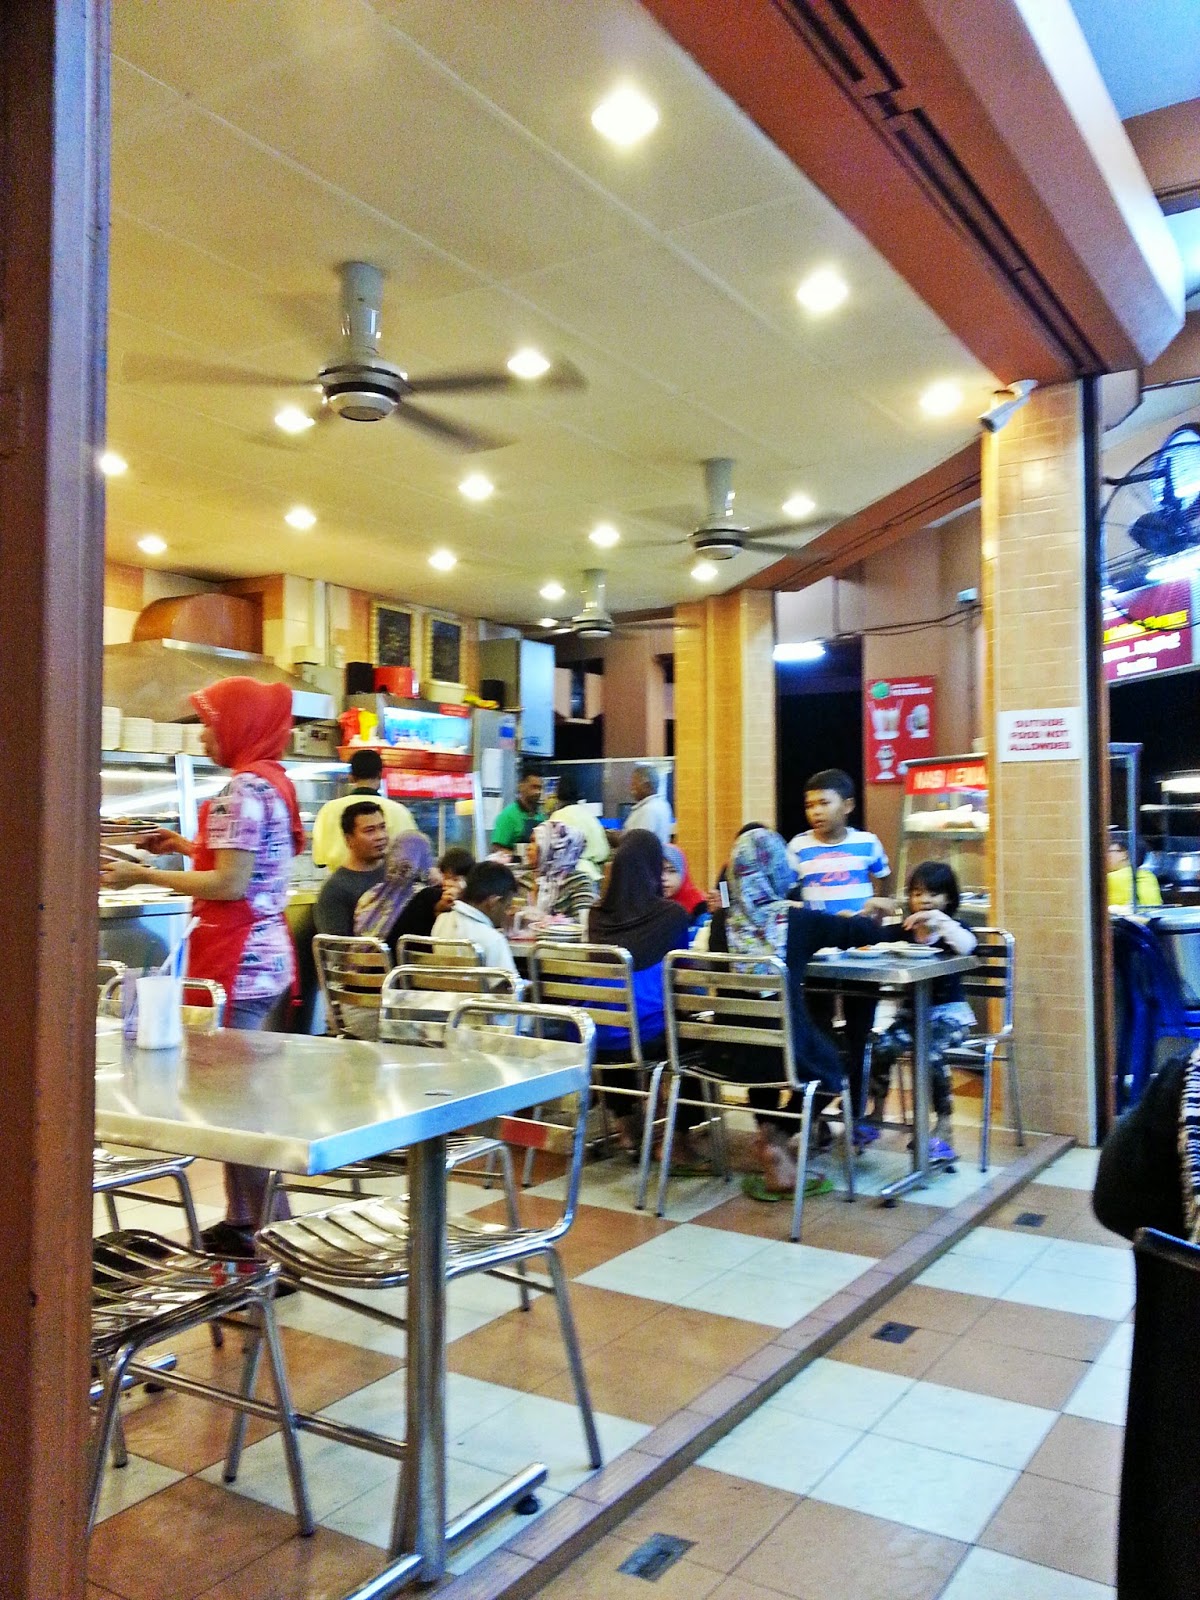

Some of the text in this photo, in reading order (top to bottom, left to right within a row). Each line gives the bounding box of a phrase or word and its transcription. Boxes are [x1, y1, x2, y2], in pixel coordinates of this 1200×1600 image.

[1013, 718, 1065, 728] OUTSIDE
[1009, 729, 1070, 740] FOOD NOT
[913, 768, 946, 789] NASI
